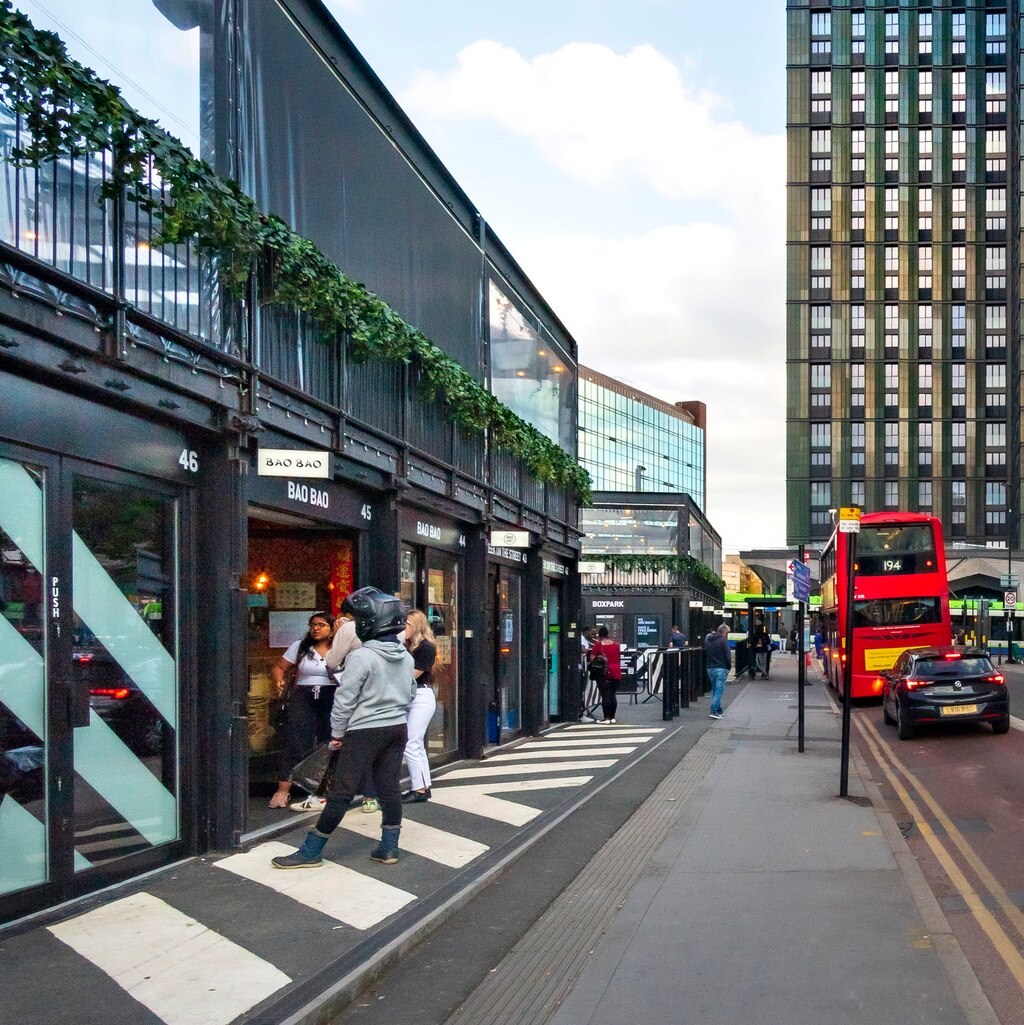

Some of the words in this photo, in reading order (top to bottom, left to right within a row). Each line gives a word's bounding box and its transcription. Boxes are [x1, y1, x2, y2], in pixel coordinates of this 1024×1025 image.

[179, 449, 198, 472] 46
[265, 457, 292, 468] BAO
[296, 458, 322, 469] BAO
[288, 481, 308, 503] BAO
[310, 488, 329, 509] BAO
[361, 504, 372, 520] 45
[417, 521, 429, 536] BAO
[429, 524, 441, 540] BAO
[459, 535, 466, 547] 44
[883, 560, 901, 571] 194
[52, 577, 60, 618] PUSH
